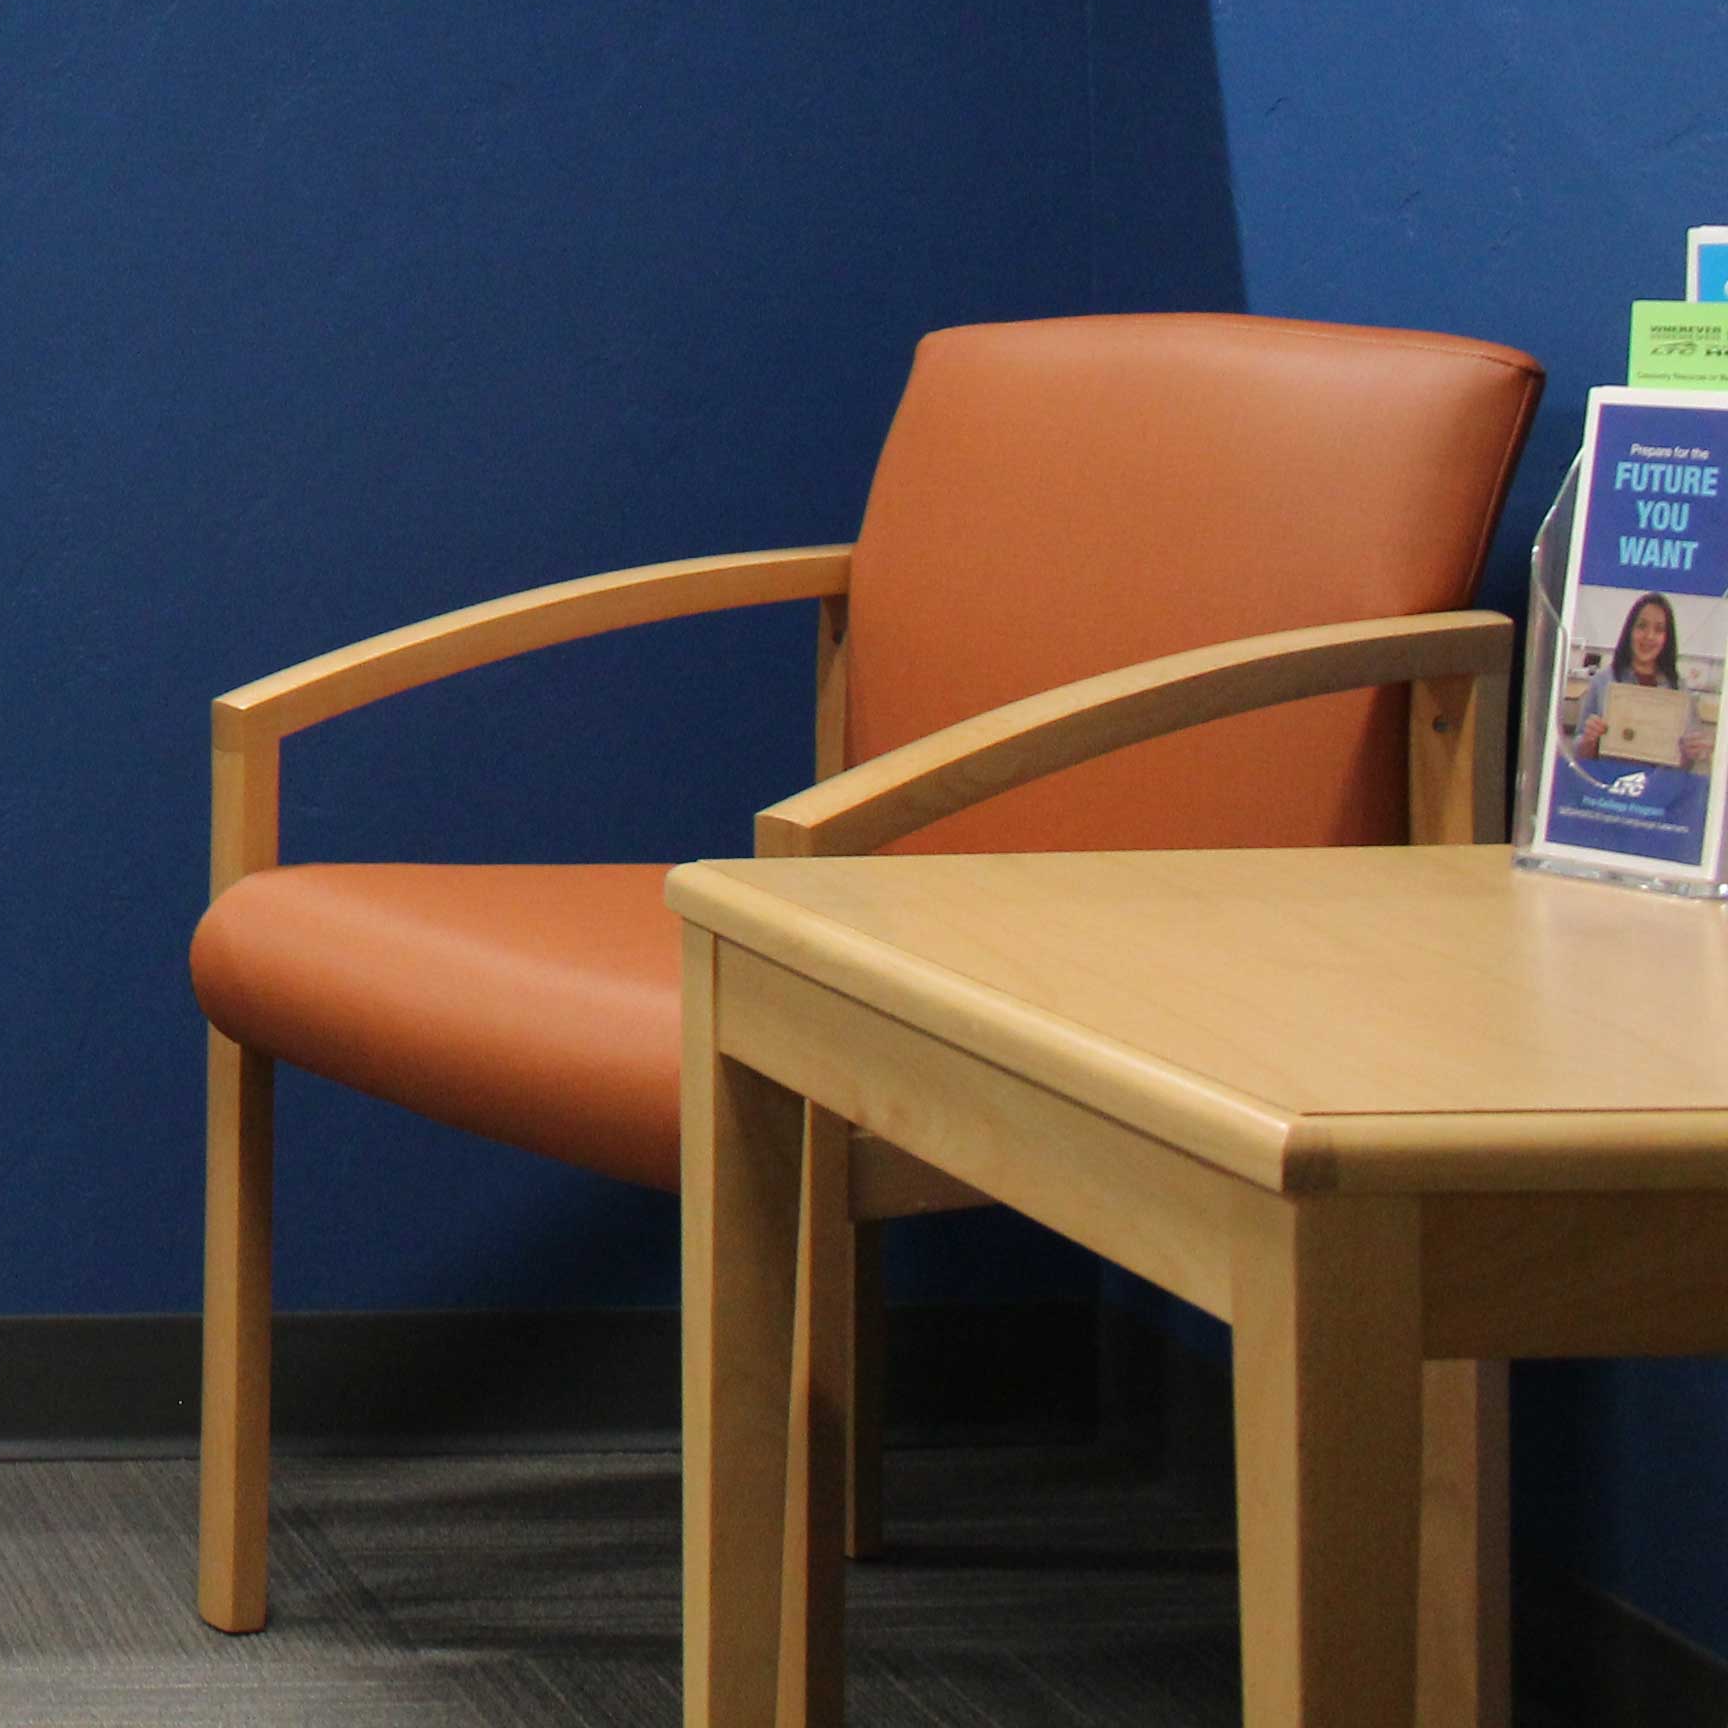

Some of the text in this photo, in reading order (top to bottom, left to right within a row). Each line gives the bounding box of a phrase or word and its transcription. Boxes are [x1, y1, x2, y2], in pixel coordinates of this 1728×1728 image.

[1630, 442, 1710, 461] Prepare for the
[1614, 461, 1720, 496] FUTURE
[1636, 500, 1690, 532] YOU
[1619, 536, 1699, 571] WANT
